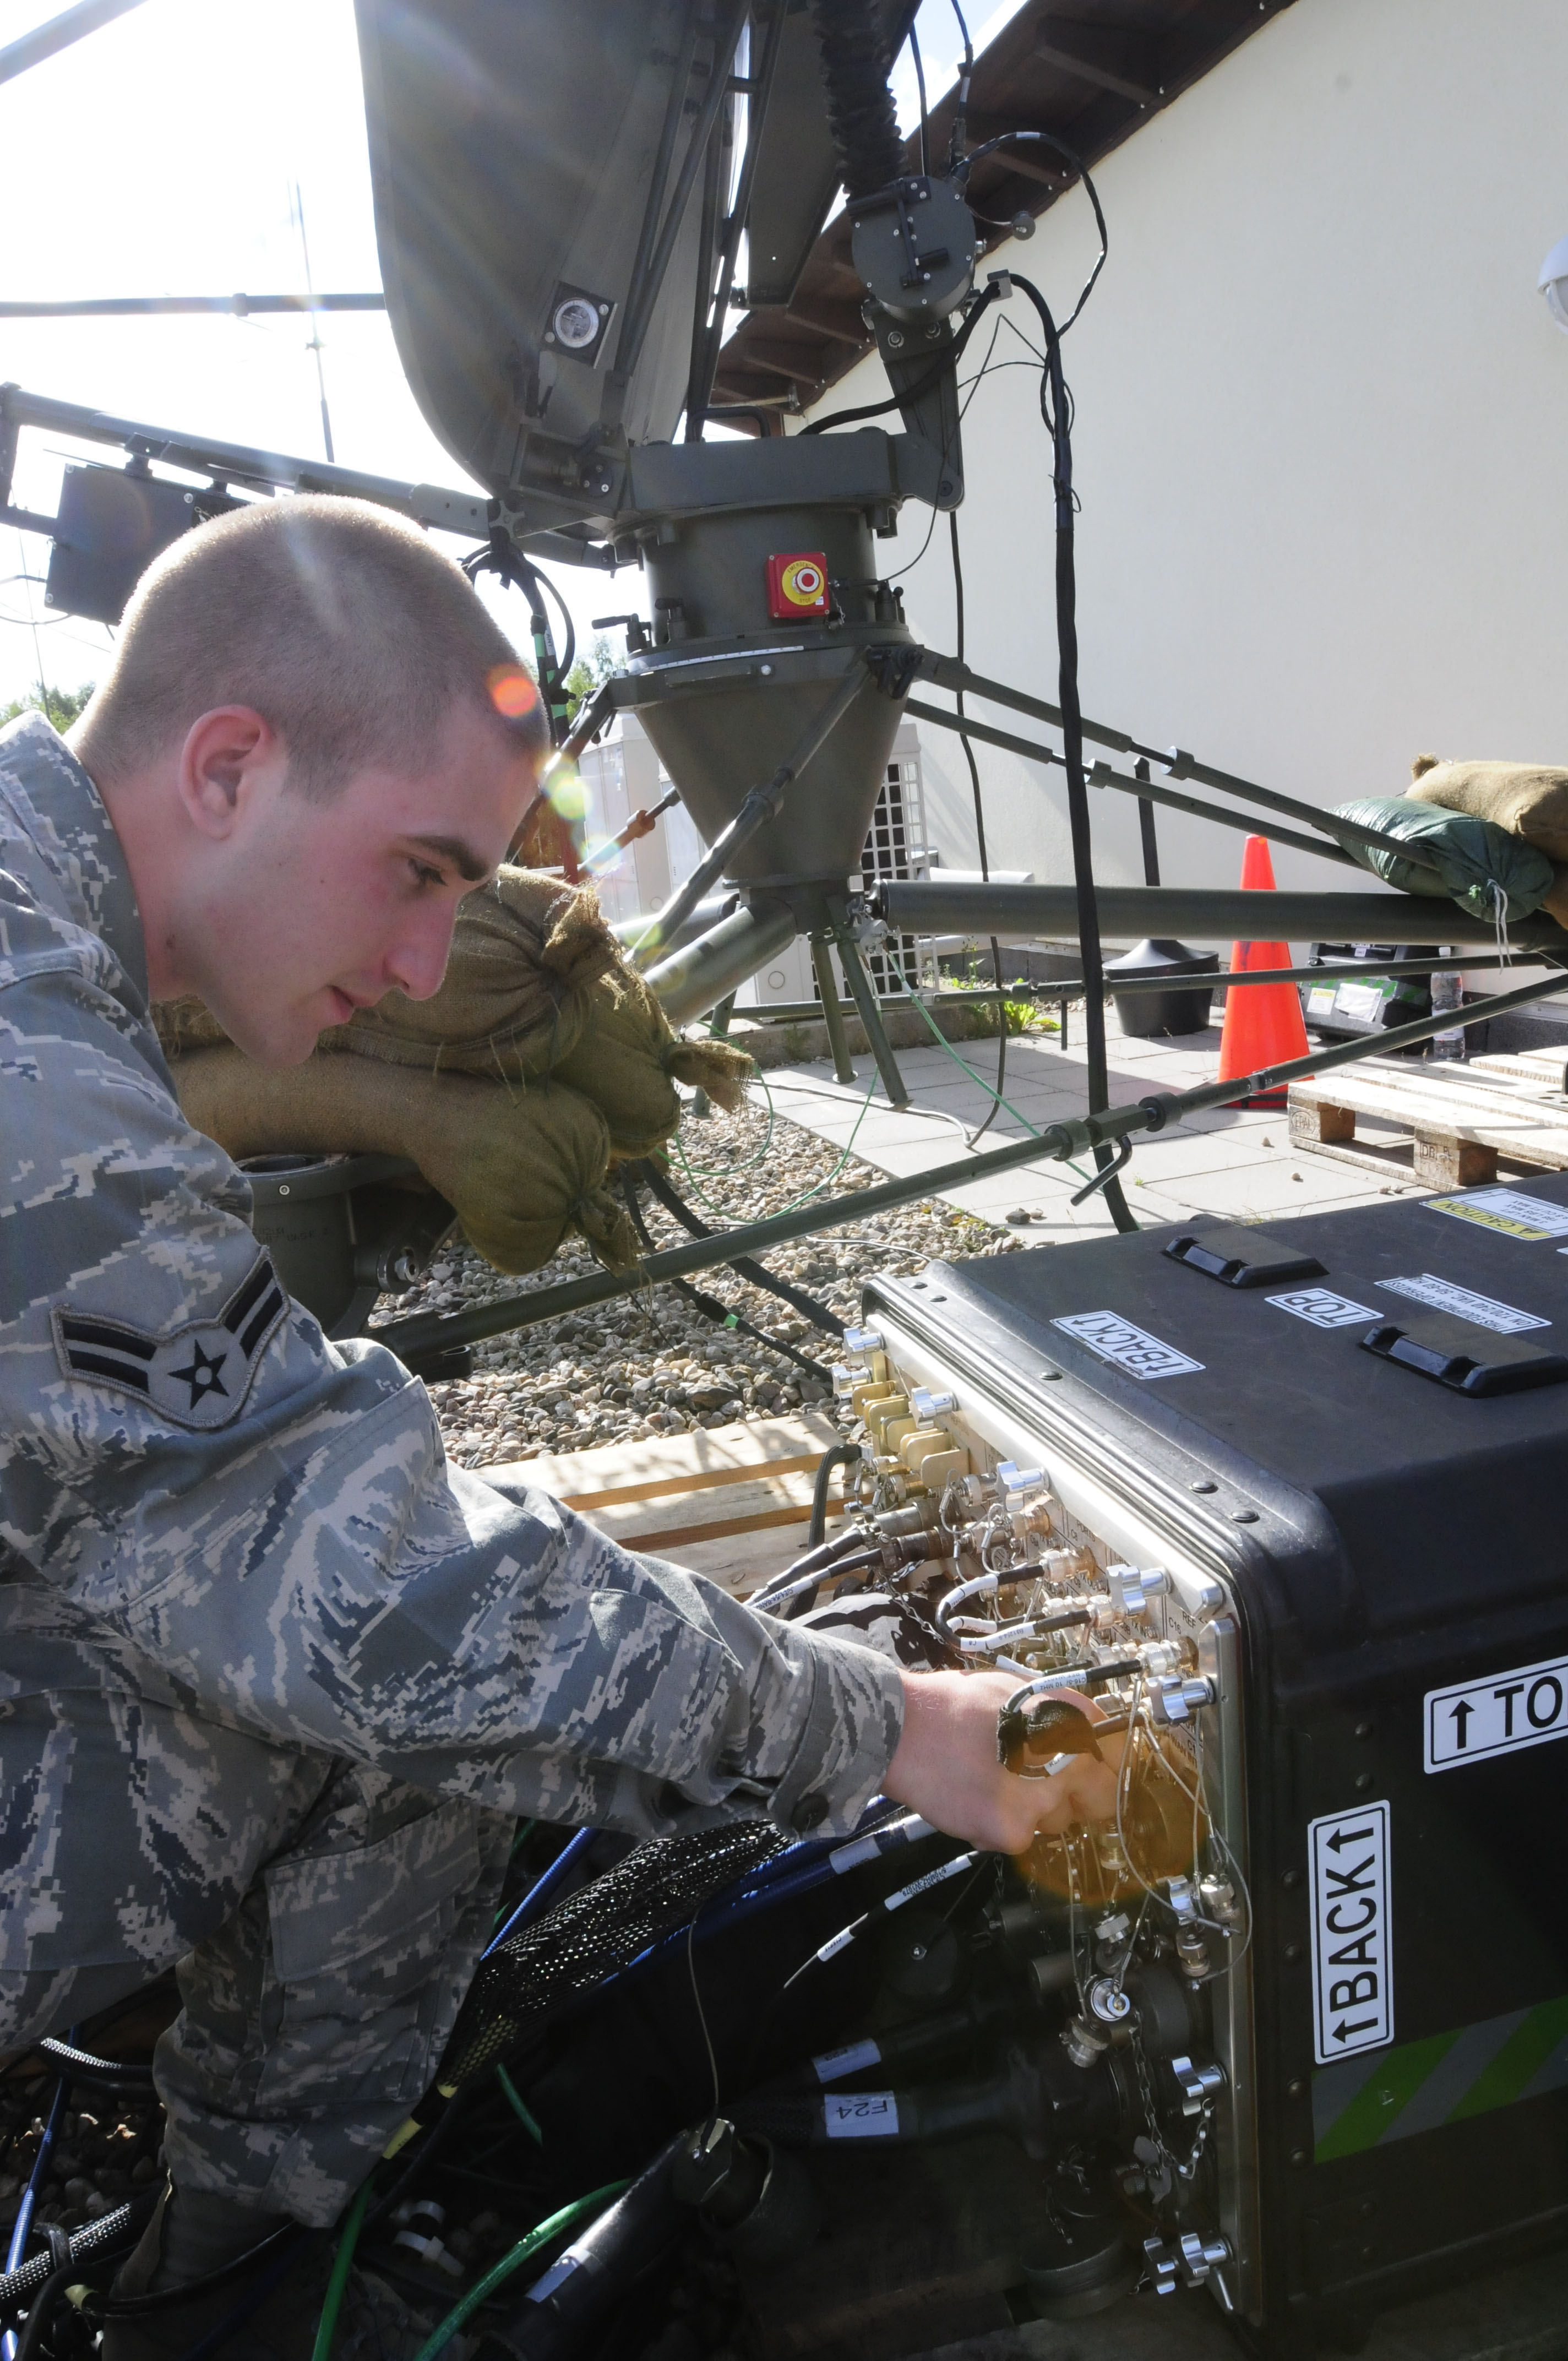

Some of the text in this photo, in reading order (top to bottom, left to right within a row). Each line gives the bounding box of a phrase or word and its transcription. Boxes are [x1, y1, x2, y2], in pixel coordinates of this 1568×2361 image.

[1439, 1203, 1516, 1228] CAUTION
[1284, 1296, 1363, 1323] TOP
[1387, 1282, 1509, 1330] THIS EQUIPMENT OPERATES
[1471, 1303, 1515, 1322] 120/240
[1079, 1323, 1172, 1364] BACK
[1169, 1617, 1182, 1635] C16
[1183, 1611, 1196, 1629] REF
[1494, 1675, 1568, 1737] TO
[1326, 1853, 1378, 2013] BACK
[836, 2100, 888, 2120] F24
